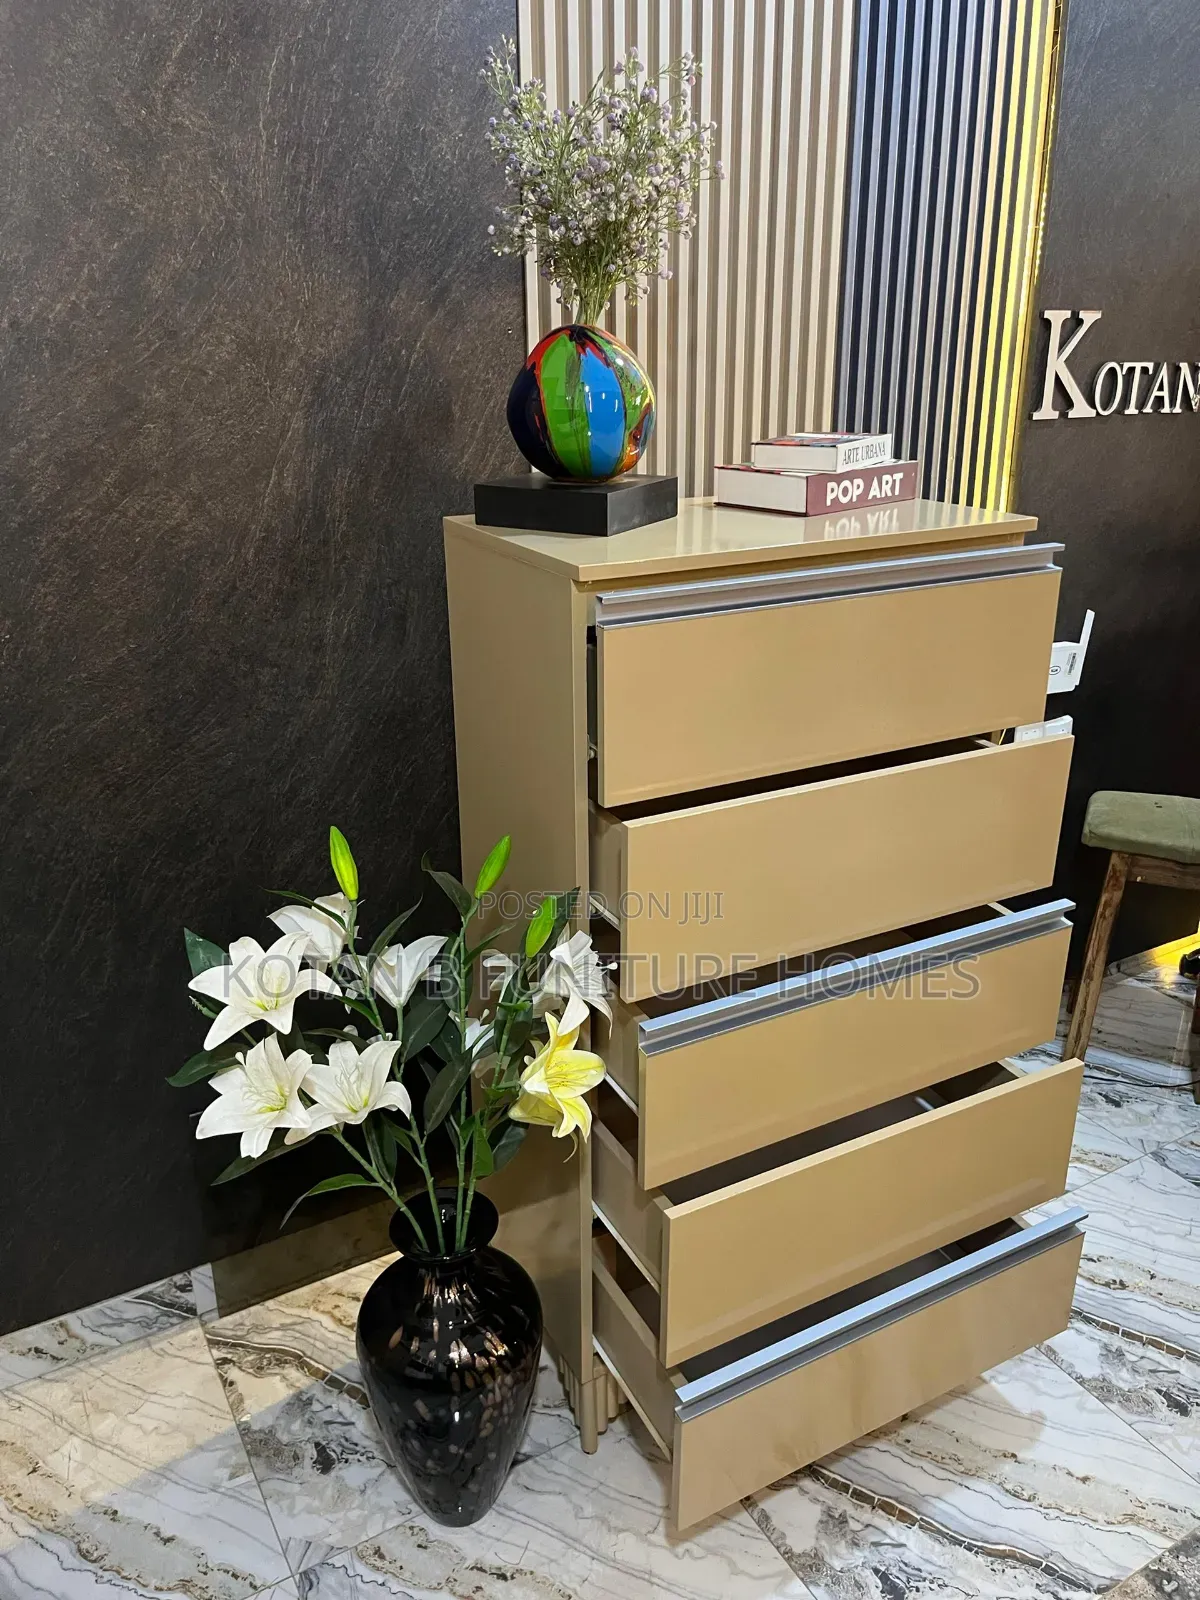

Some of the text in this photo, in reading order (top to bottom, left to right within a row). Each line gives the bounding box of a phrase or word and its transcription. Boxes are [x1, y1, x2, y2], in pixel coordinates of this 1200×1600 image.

[843, 441, 886, 465] ARTE URBANA
[826, 472, 903, 507] POP ART
